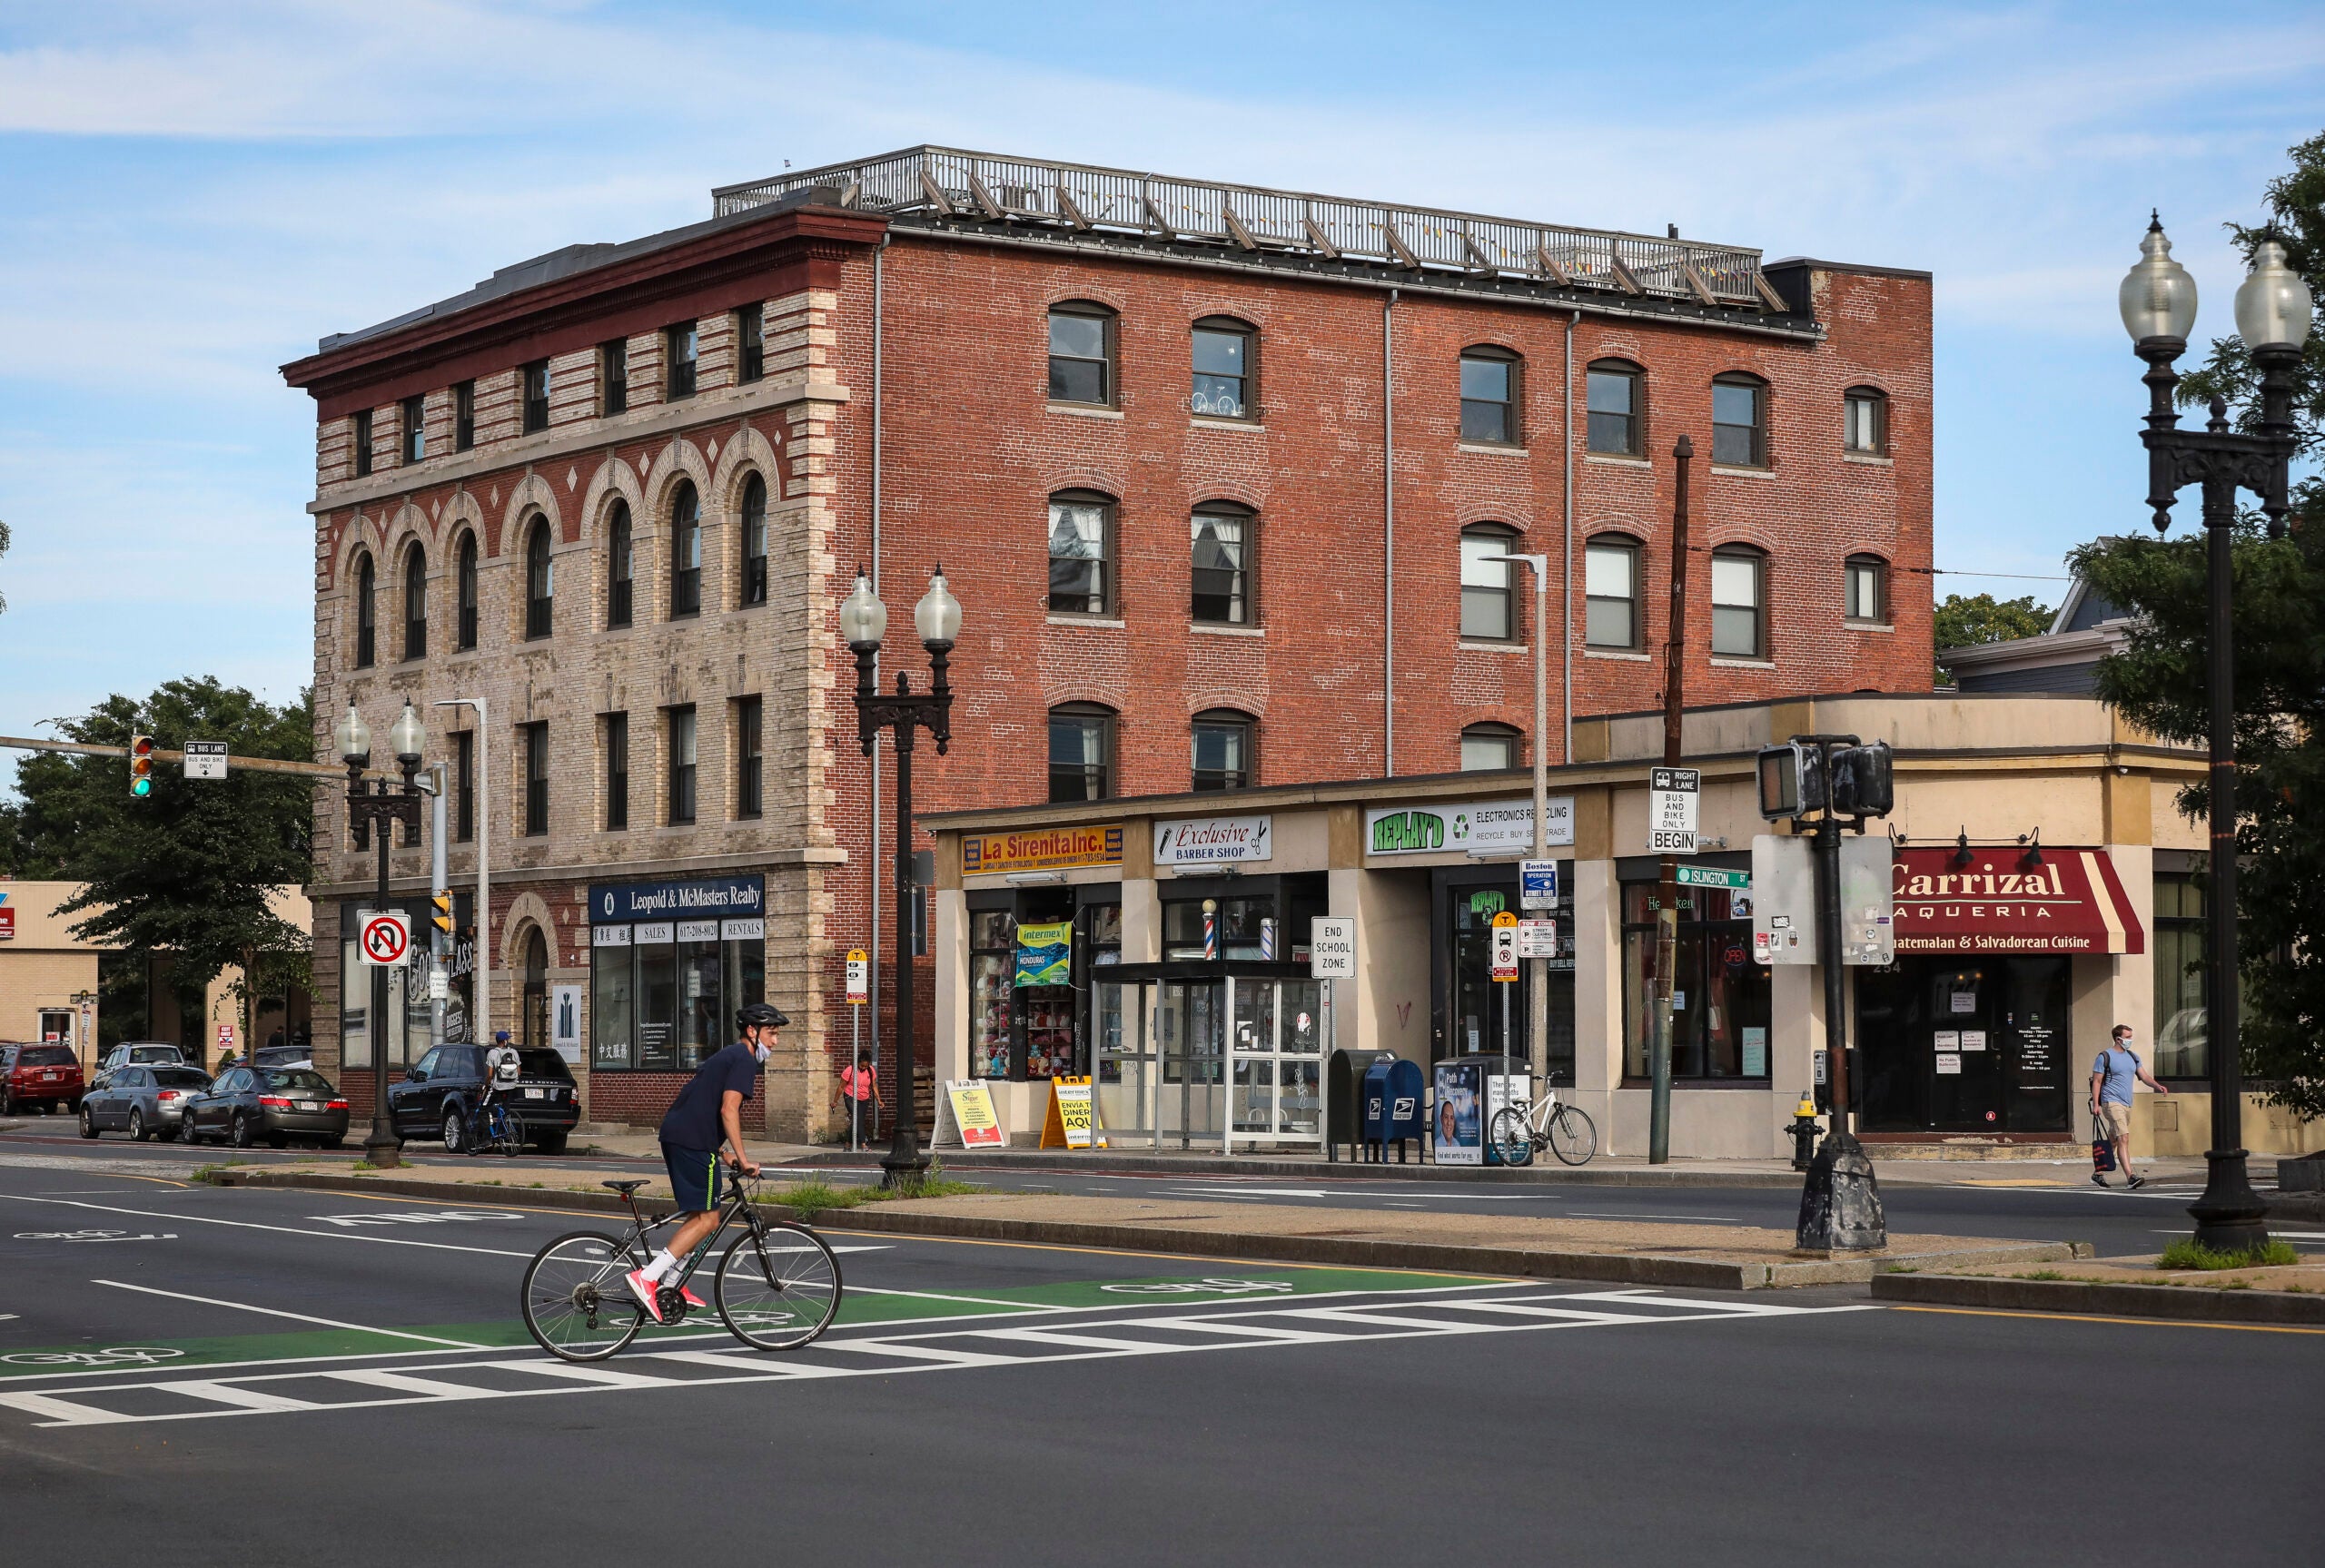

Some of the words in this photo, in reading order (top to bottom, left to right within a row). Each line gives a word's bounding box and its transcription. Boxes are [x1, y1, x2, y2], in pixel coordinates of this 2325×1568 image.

[198, 745, 209, 753] BUS
[211, 745, 225, 753] LANE
[1675, 772, 1697, 781] RIGHT
[1676, 782, 1695, 790] LANE
[1665, 794, 1684, 802] BUS
[1665, 803, 1685, 811] AND
[1476, 808, 1525, 823] ELECTRONICS
[1526, 806, 1567, 820] RECLING
[1664, 812, 1685, 820] BIKE
[1662, 820, 1686, 829] ONLY
[1175, 822, 1250, 847] Exclusive
[1372, 811, 1445, 853] REPLAY'D
[1476, 831, 1505, 841] RECYCLE
[1509, 829, 1523, 839] BUY
[1546, 827, 1567, 836] TRADE
[1654, 832, 1695, 849] BEGIN
[983, 838, 1002, 861] La
[1176, 848, 1214, 860] BARBER
[1217, 846, 1245, 858] SHOP
[1691, 870, 1729, 885] ISLINGTON
[1739, 874, 1746, 883] ST
[1892, 863, 2066, 896] Carrizal
[630, 889, 667, 914] Leopold
[668, 889, 678, 908] &
[678, 887, 728, 907] McMasters
[729, 884, 761, 909] Realty
[1647, 896, 1694, 911] Heken
[1893, 906, 2052, 920] AQUERIA
[644, 926, 666, 940] SALES
[679, 924, 717, 937] 617-208-8020
[727, 922, 760, 936] RENTALS
[1024, 930, 1061, 940] intermex
[1324, 926, 1342, 937] END
[1316, 942, 1351, 953] SCHOOL
[1893, 936, 1955, 949] atemalan
[1959, 935, 1972, 949] &
[1975, 934, 2049, 949] Salvadorean
[2051, 935, 2090, 949] Cuisine
[1019, 955, 1045, 965] HONDURAS
[1725, 949, 1746, 962] OPEN
[1322, 958, 1346, 969] ZONE
[1873, 962, 1902, 973] 254
[409, 943, 431, 1000] GOO
[599, 1041, 628, 1060] 中文服務
[1446, 1072, 1458, 1084] Path
[1061, 1100, 1084, 1109] ENVÍA
[1063, 1109, 1092, 1117] DINER
[1066, 1117, 1092, 1129] AQU
